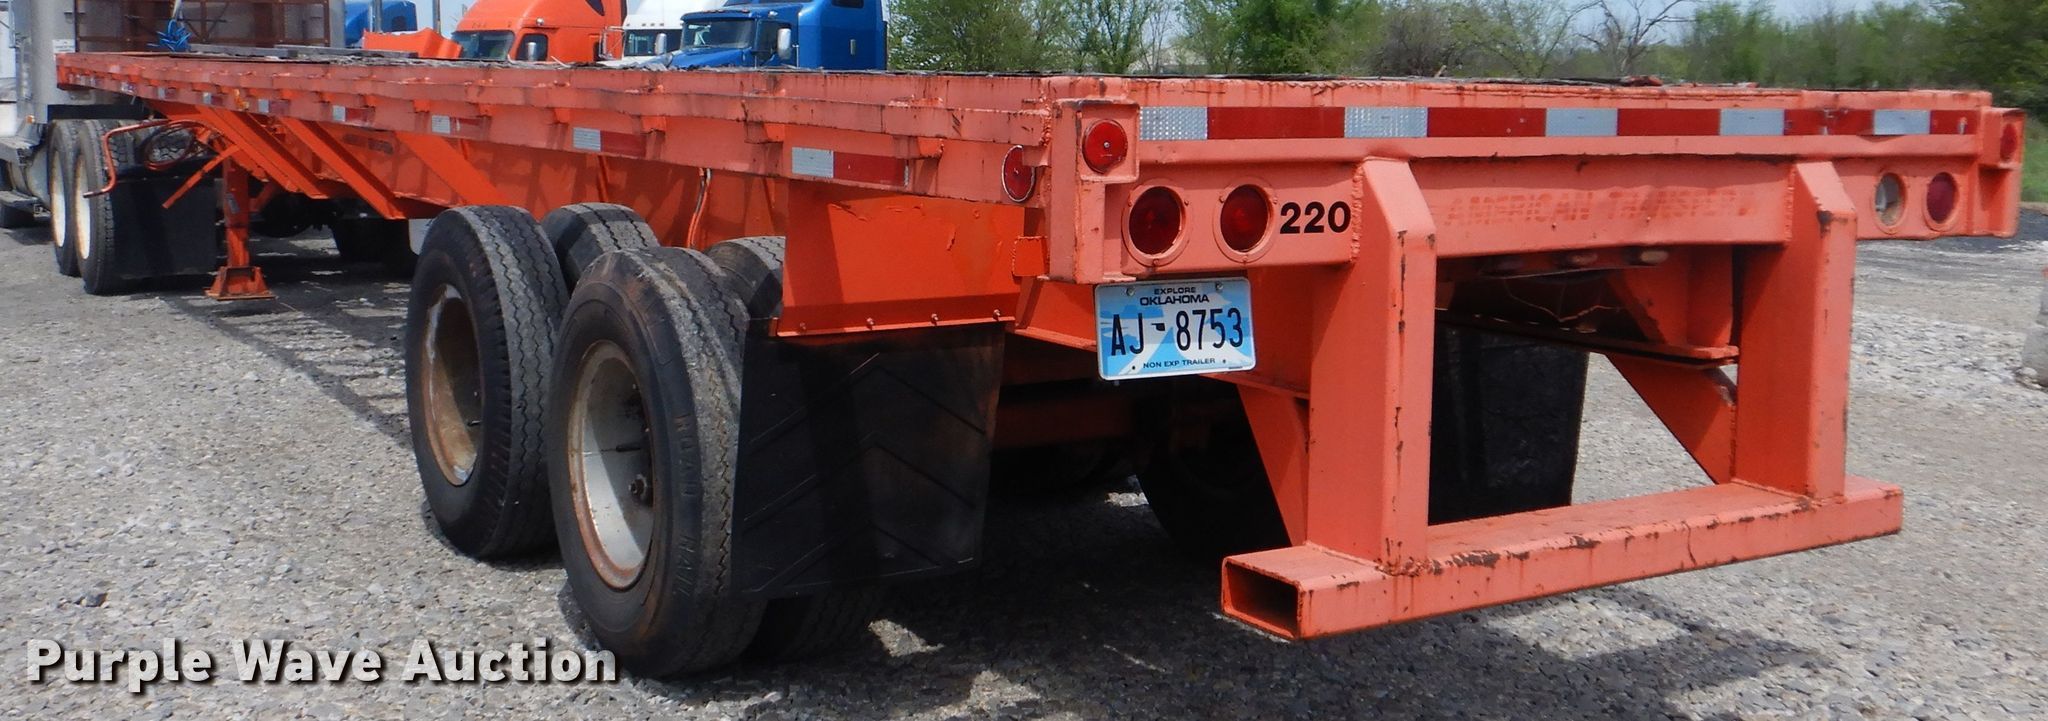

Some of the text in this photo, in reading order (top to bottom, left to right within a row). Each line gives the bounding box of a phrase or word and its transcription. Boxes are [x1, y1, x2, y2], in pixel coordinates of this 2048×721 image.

[1280, 201, 1351, 234] 220
[1153, 286, 1197, 296] EXPLORE
[1139, 294, 1210, 306] OKLAHOMA
[1142, 357, 1216, 370] NON EXP TRAILER
